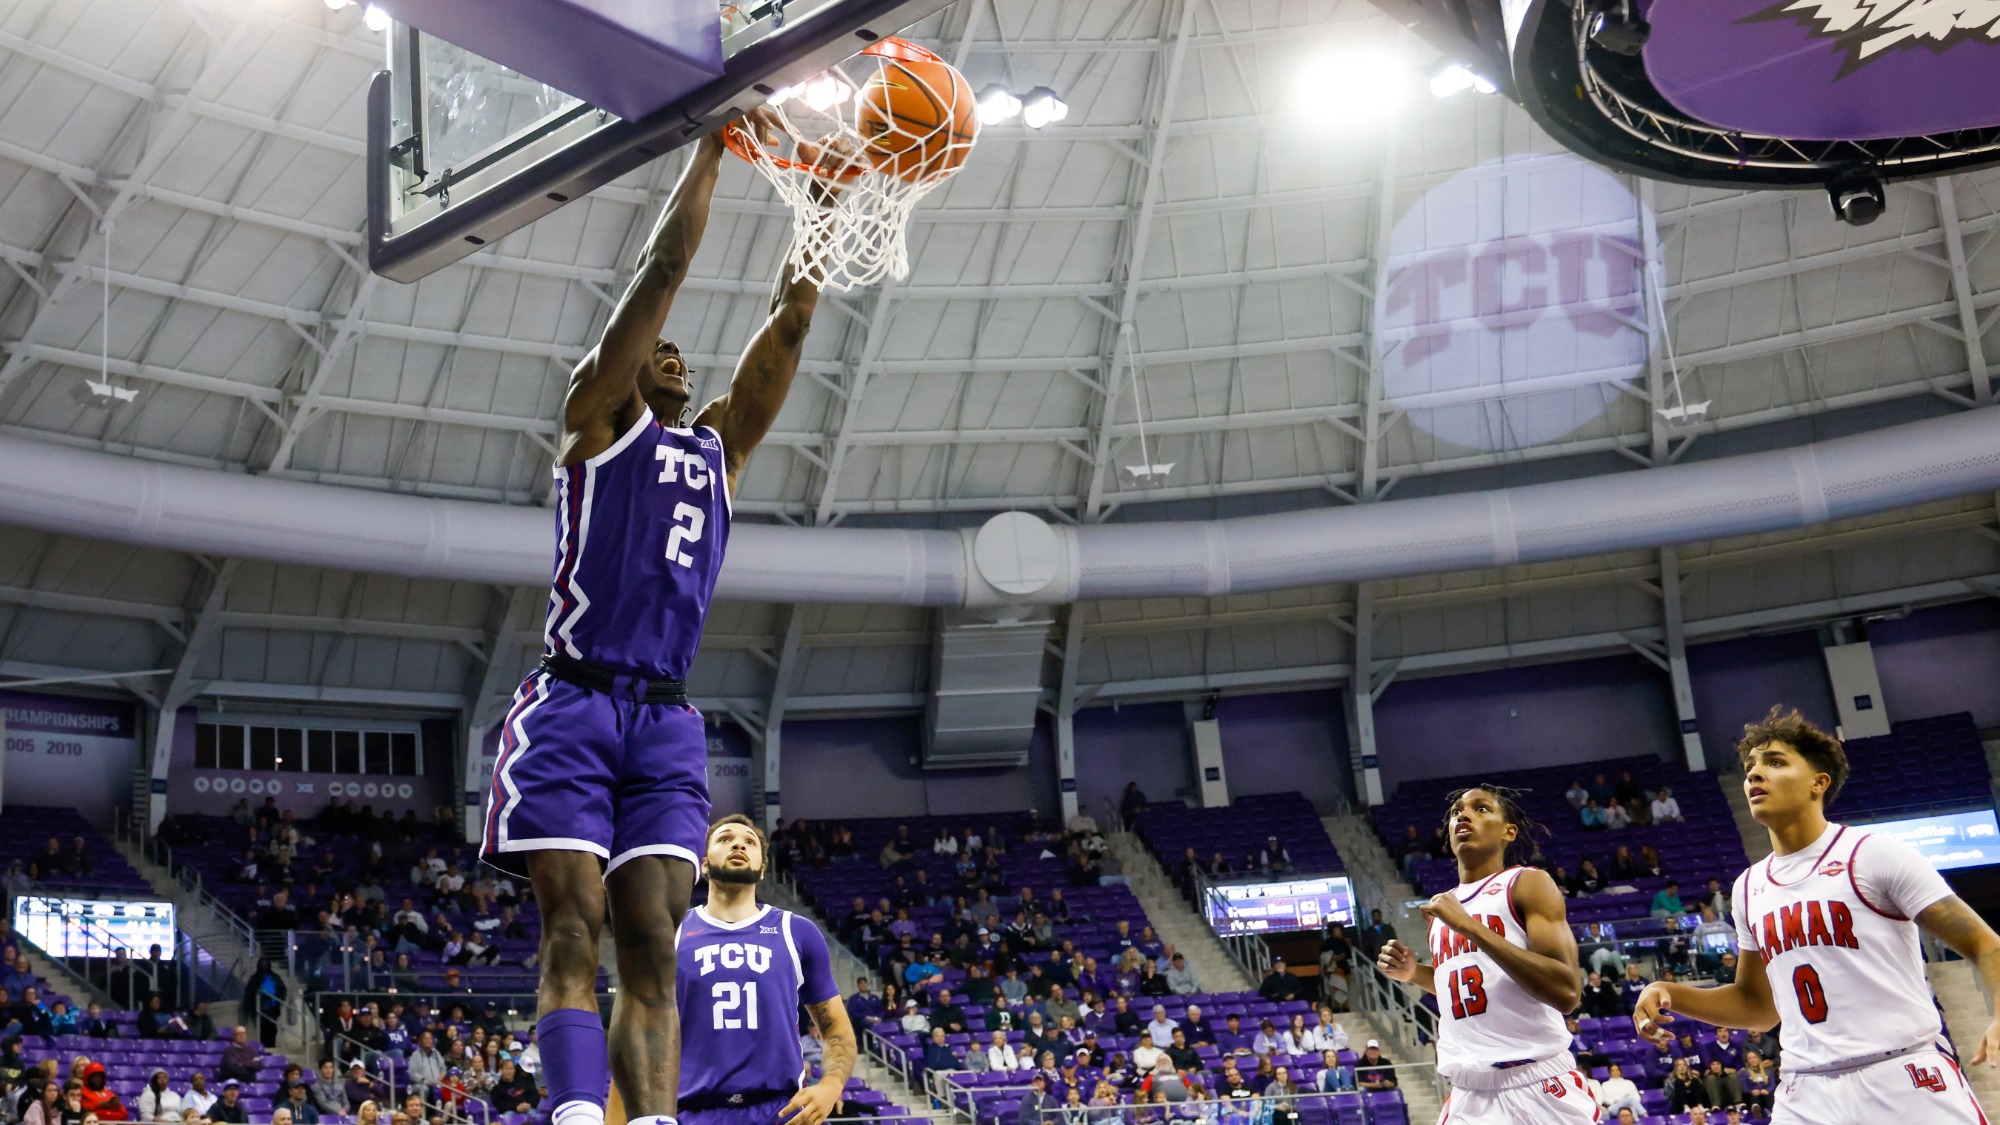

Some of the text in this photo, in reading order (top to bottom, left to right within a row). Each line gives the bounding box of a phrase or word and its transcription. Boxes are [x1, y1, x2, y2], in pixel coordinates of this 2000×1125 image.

[1385, 231, 1641, 369] TCU
[665, 501, 706, 569] 2
[5, 737, 82, 756] 005 2010
[715, 764, 748, 778] 2006
[694, 942, 773, 977] TCU
[711, 981, 758, 1030] 21
[1448, 965, 1488, 1020] 13
[1792, 963, 1829, 1025] 0
